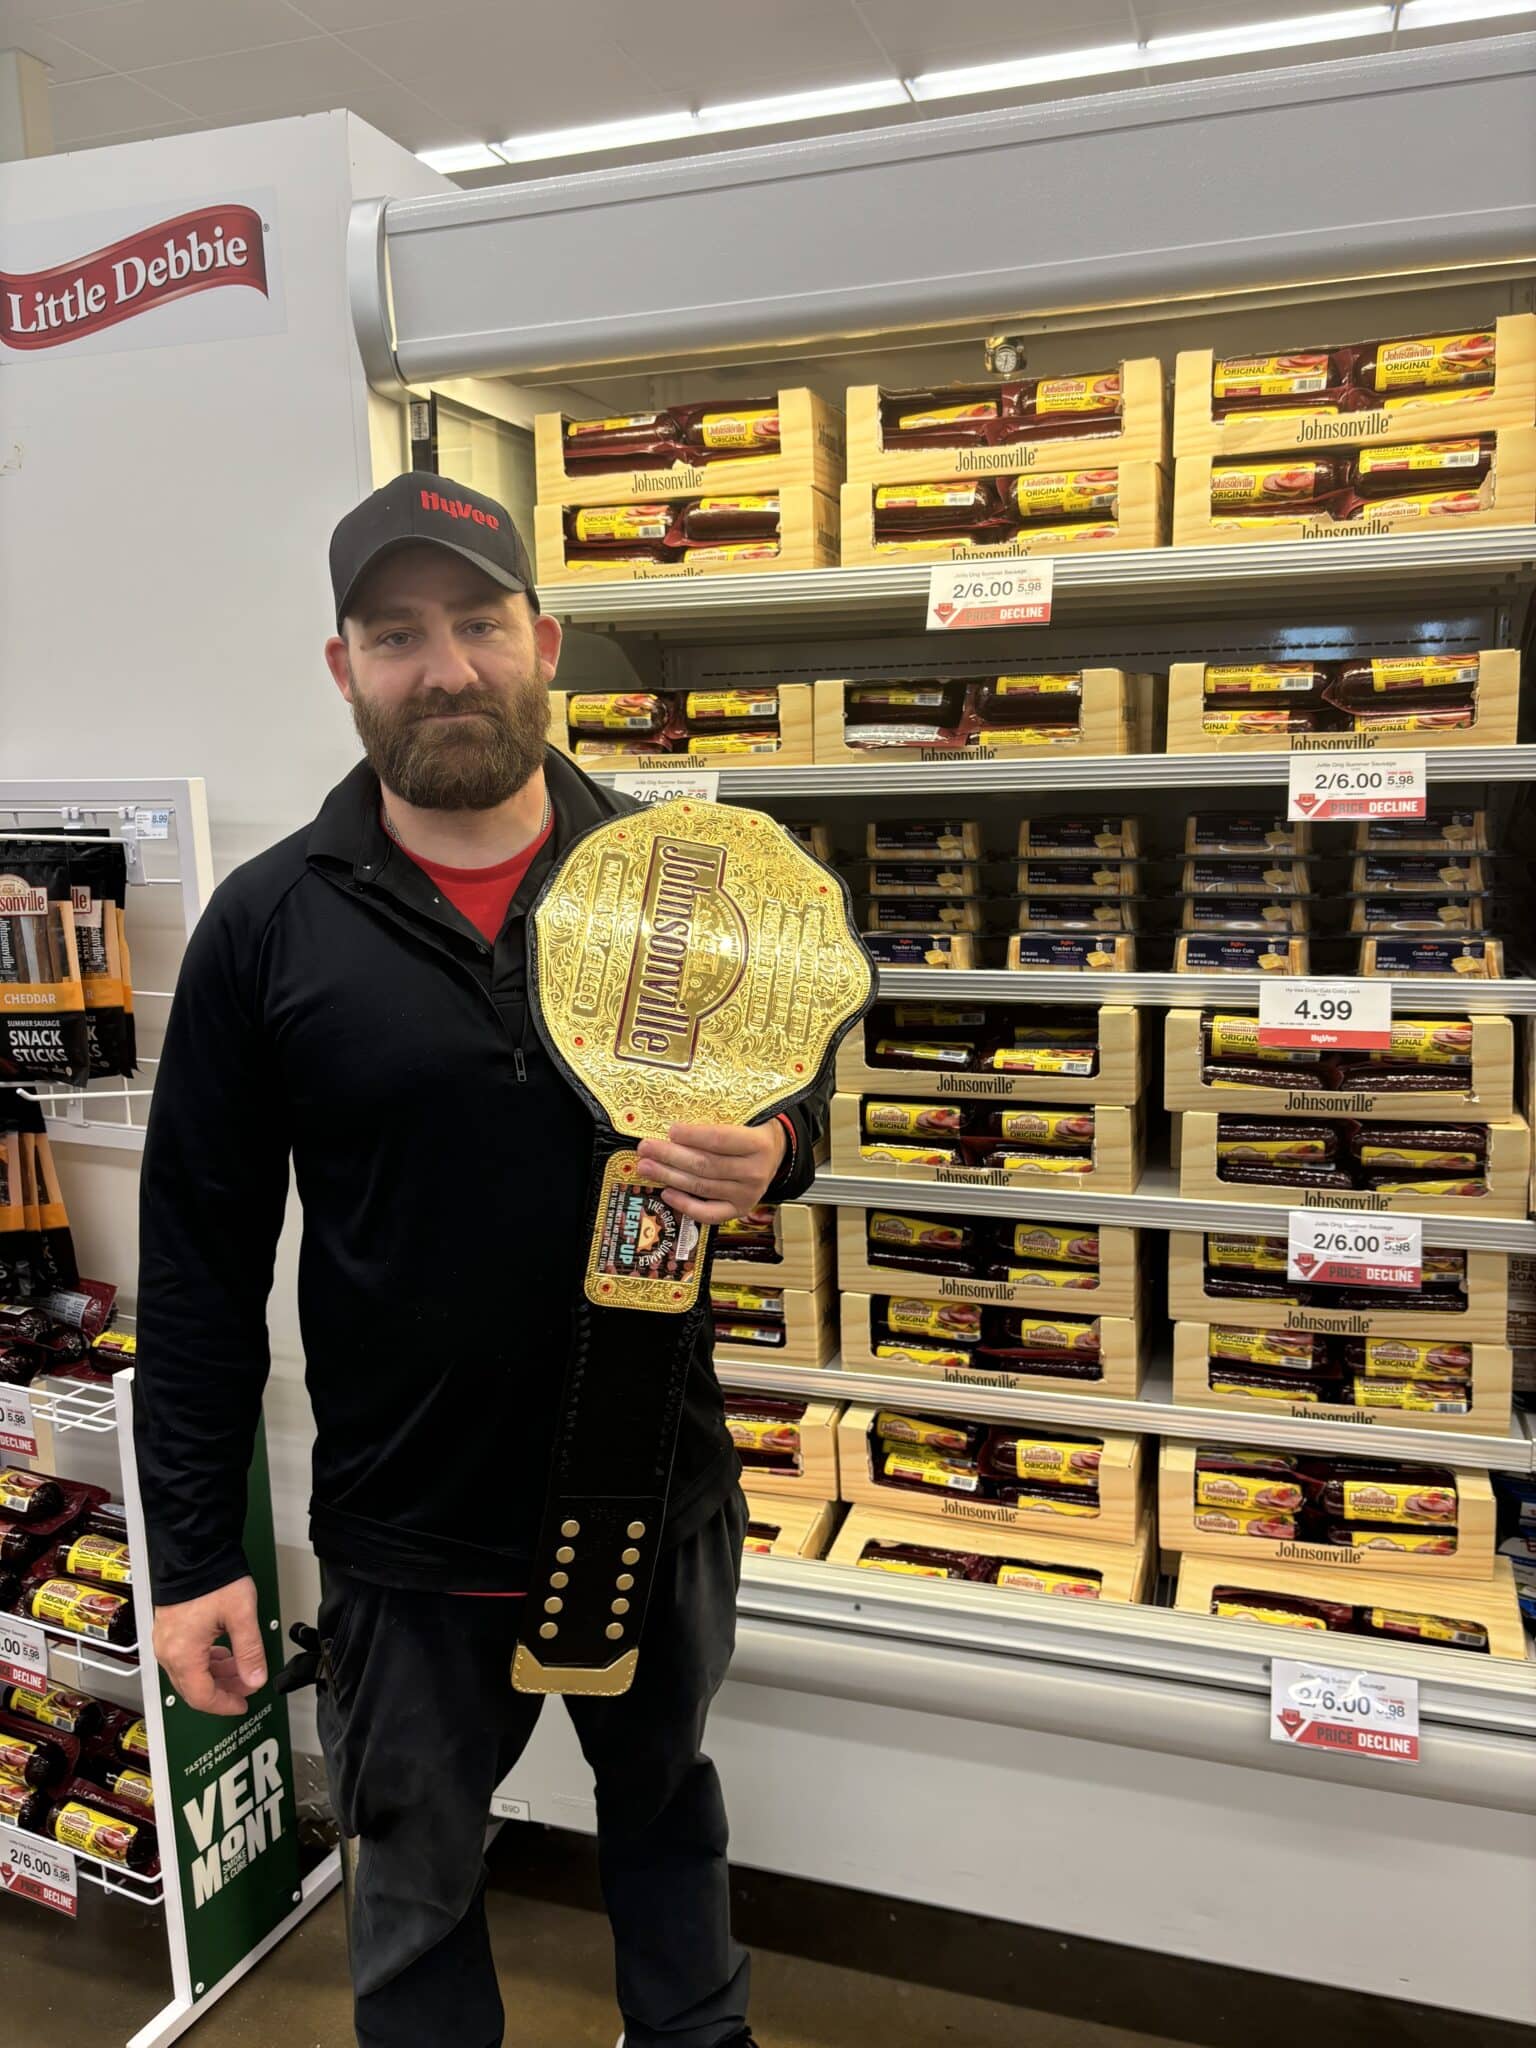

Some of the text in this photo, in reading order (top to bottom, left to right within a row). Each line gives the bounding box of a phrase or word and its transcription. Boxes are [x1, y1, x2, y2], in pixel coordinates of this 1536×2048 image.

[7, 226, 249, 333] Little Debbie
[1384, 348, 1434, 362] Johnsonville
[1223, 366, 1266, 376] ORIGINAL
[1385, 360, 1432, 372] ORIGINAL
[1297, 414, 1389, 442] Johnsonville
[955, 448, 1036, 473] Johnsonville
[632, 471, 702, 494] Johnsonville
[1025, 486, 1066, 497] ORIGINAL
[1302, 521, 1390, 539] Johnsonville
[952, 545, 1030, 560] Johnsonville
[953, 581, 1042, 598] 2/6.00 5.98
[1000, 606, 1043, 619] DECLINE
[1214, 666, 1256, 675] ORIGINAL
[1291, 737, 1377, 751] Johnsonville
[1315, 773, 1415, 789] 2/6.00 5.98
[1330, 801, 1418, 813] PRICE DECLINE
[0, 890, 45, 912] sonville
[631, 844, 716, 1056] Johnsonville
[4, 993, 57, 1004] CHEDDAR
[748, 972, 769, 1027] WORLD
[1294, 1000, 1352, 1020] 4.99
[789, 1006, 807, 1039] THE
[9, 1029, 64, 1046] SNACK
[1221, 1033, 1258, 1042] ORIGINA
[1391, 1038, 1424, 1047] IGINAL
[12, 1048, 69, 1062] STICKS
[937, 1073, 1013, 1095] Johnsonville
[1284, 1091, 1374, 1113] Johnsonville
[934, 1168, 1011, 1187] Johnsonville
[1300, 1190, 1390, 1209] Johnsonville
[619, 1196, 643, 1265] MEAT-UP
[638, 1199, 676, 1267] THE GREAT SUMMER
[1313, 1233, 1411, 1252] 2/6.00 5.98
[1329, 1266, 1414, 1282] PRICE DECLINE
[1511, 1260, 1536, 1271] BEE
[1509, 1271, 1536, 1282] ROA
[939, 1279, 1016, 1301] Johnsonville
[1283, 1310, 1371, 1334] Johnsonville
[942, 1369, 1017, 1388] Johnsonville
[8, 1412, 26, 1424] 5.98
[940, 1498, 1017, 1523] Johnsonville
[1276, 1541, 1363, 1565] Johnsonville
[13, 1668, 42, 1689] DECLINE
[184, 1703, 272, 1776] TASTES RIGHT BECAUSE
[1317, 1727, 1411, 1754] PRICE DECLINE
[199, 1760, 214, 1777] IT'S
[214, 1741, 238, 1765] MADE
[182, 1737, 283, 1853] VER
[191, 1786, 284, 1910] MONT
[10, 1849, 51, 1876] 2/6.00
[222, 1847, 248, 1875] SMOKE
[43, 1886, 73, 1909] DECLINE
